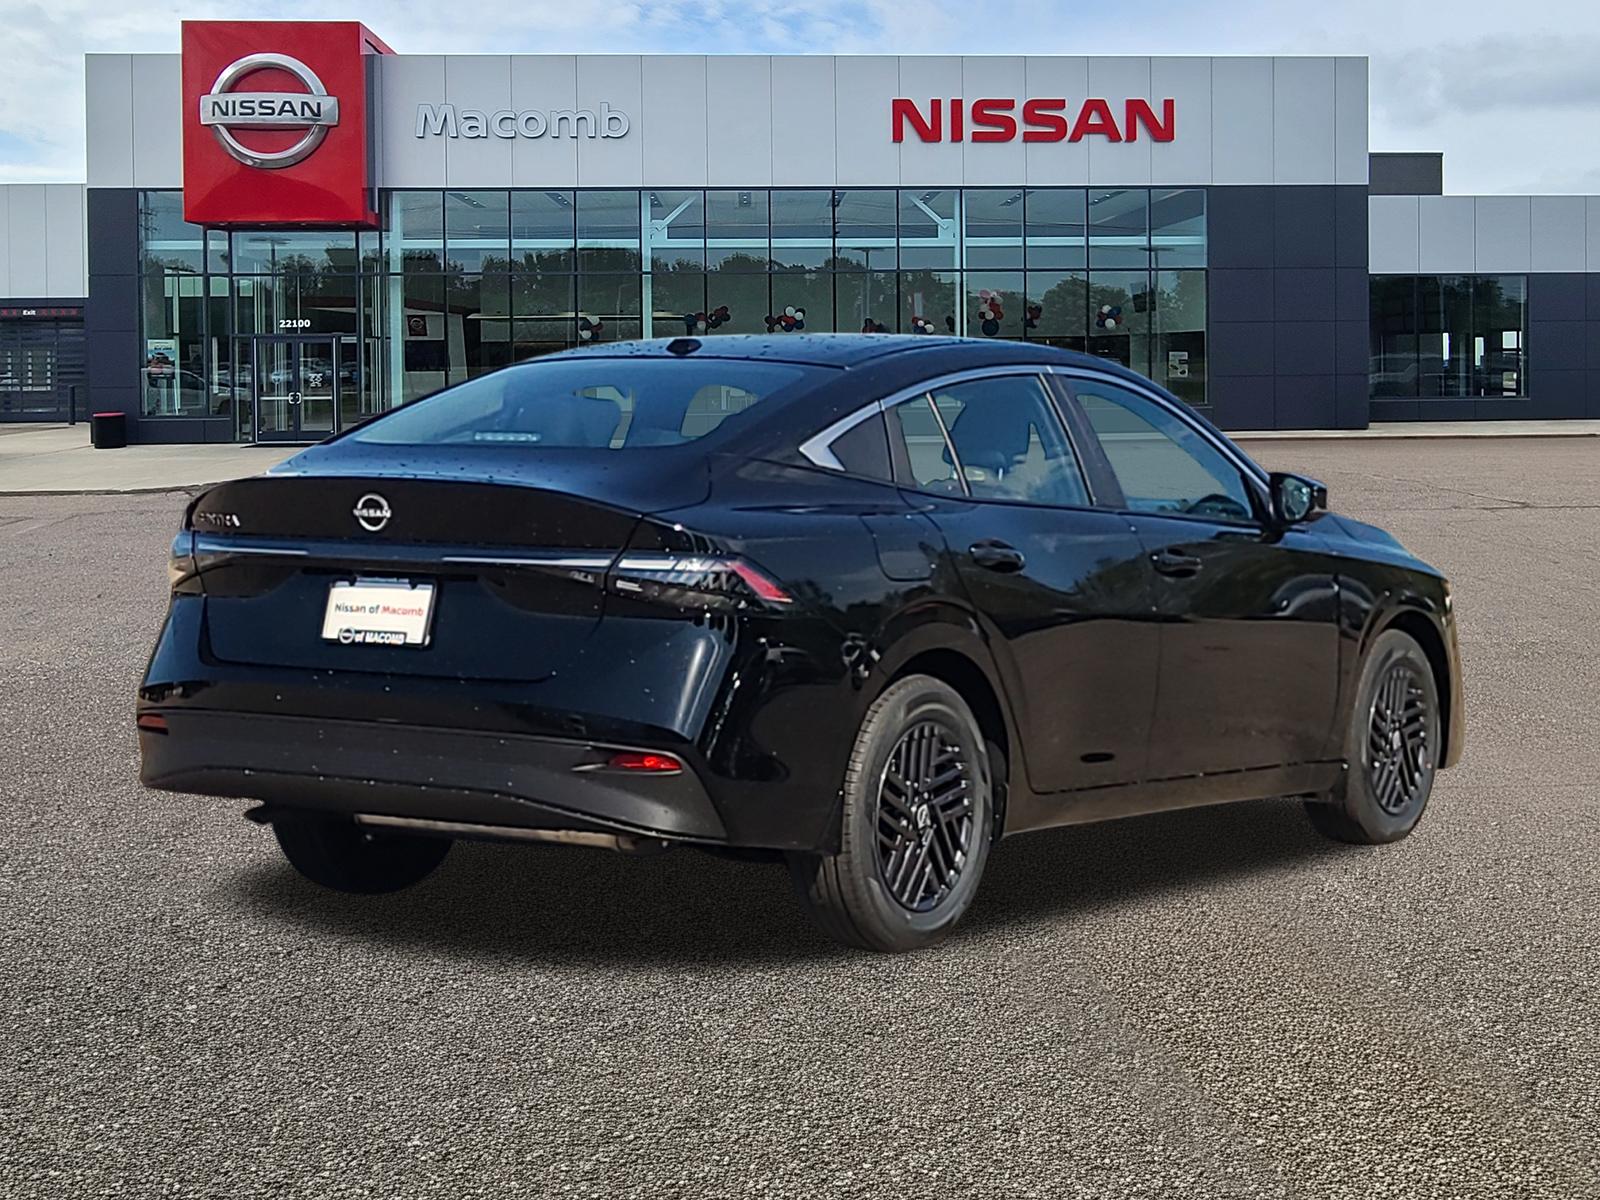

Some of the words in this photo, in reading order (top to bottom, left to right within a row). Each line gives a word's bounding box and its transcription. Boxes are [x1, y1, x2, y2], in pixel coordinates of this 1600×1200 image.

[212, 100, 322, 117] NISSAN
[415, 102, 630, 139] Macomb
[892, 98, 1175, 143] NISSAN
[279, 319, 311, 328] 22100
[334, 602, 366, 613] Nissan
[368, 604, 380, 614] of
[381, 605, 424, 616] Macomb
[365, 631, 405, 645] MACOMB
